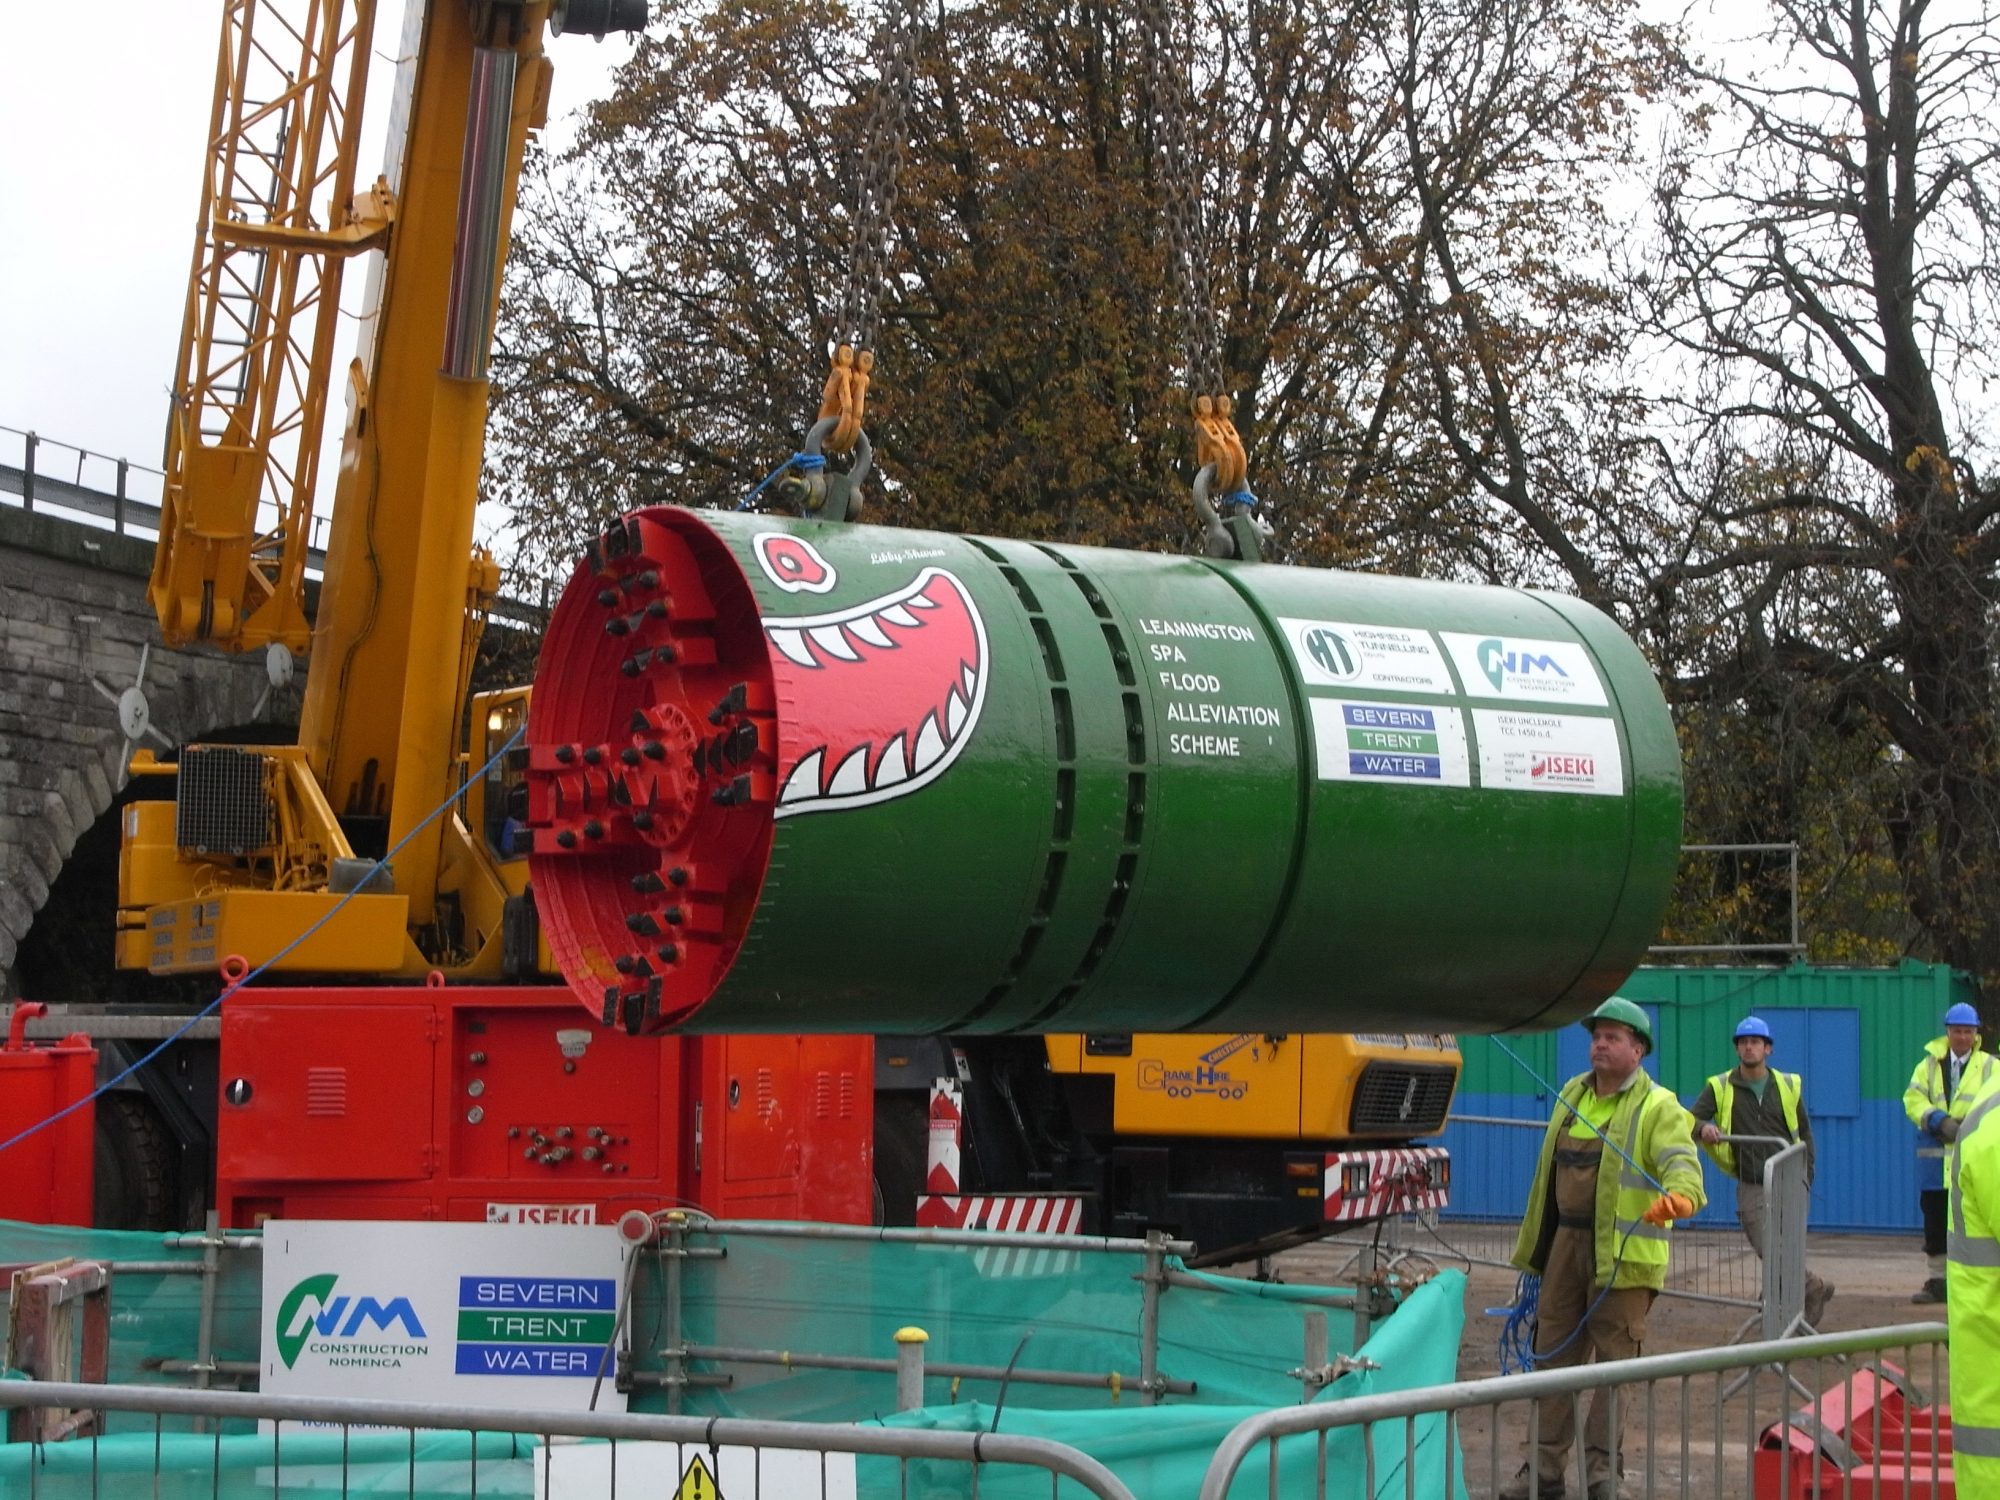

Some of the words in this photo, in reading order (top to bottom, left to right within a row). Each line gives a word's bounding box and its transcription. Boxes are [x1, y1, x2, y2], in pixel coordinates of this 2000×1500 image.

[1139, 618, 1255, 642] LEAMINGTON
[1353, 630, 1411, 642] HIGHFIELD
[1150, 644, 1186, 662] SPA
[1360, 641, 1430, 655] TUNNELLING
[1159, 672, 1220, 693] FLOOD
[1372, 673, 1433, 685] CONTRACTORS
[1167, 702, 1280, 727] ALLEVIATION
[1352, 708, 1426, 727] SEVERN
[1498, 715, 1517, 725] ISEKI
[1362, 732, 1422, 749] TRENT
[1518, 728, 1536, 738] 1450
[1170, 734, 1240, 757] SCHEME
[1364, 756, 1426, 774] WATER
[1547, 756, 1595, 776] ISEKI
[1138, 1060, 1192, 1089] CRANE
[1197, 1066, 1230, 1085] HIRE
[477, 1282, 598, 1304] SEVERN
[486, 1316, 588, 1338] TRENT
[309, 1342, 429, 1356] CONSTRUCTION
[328, 1357, 402, 1369] NOMENCA
[484, 1350, 588, 1371] WATER
